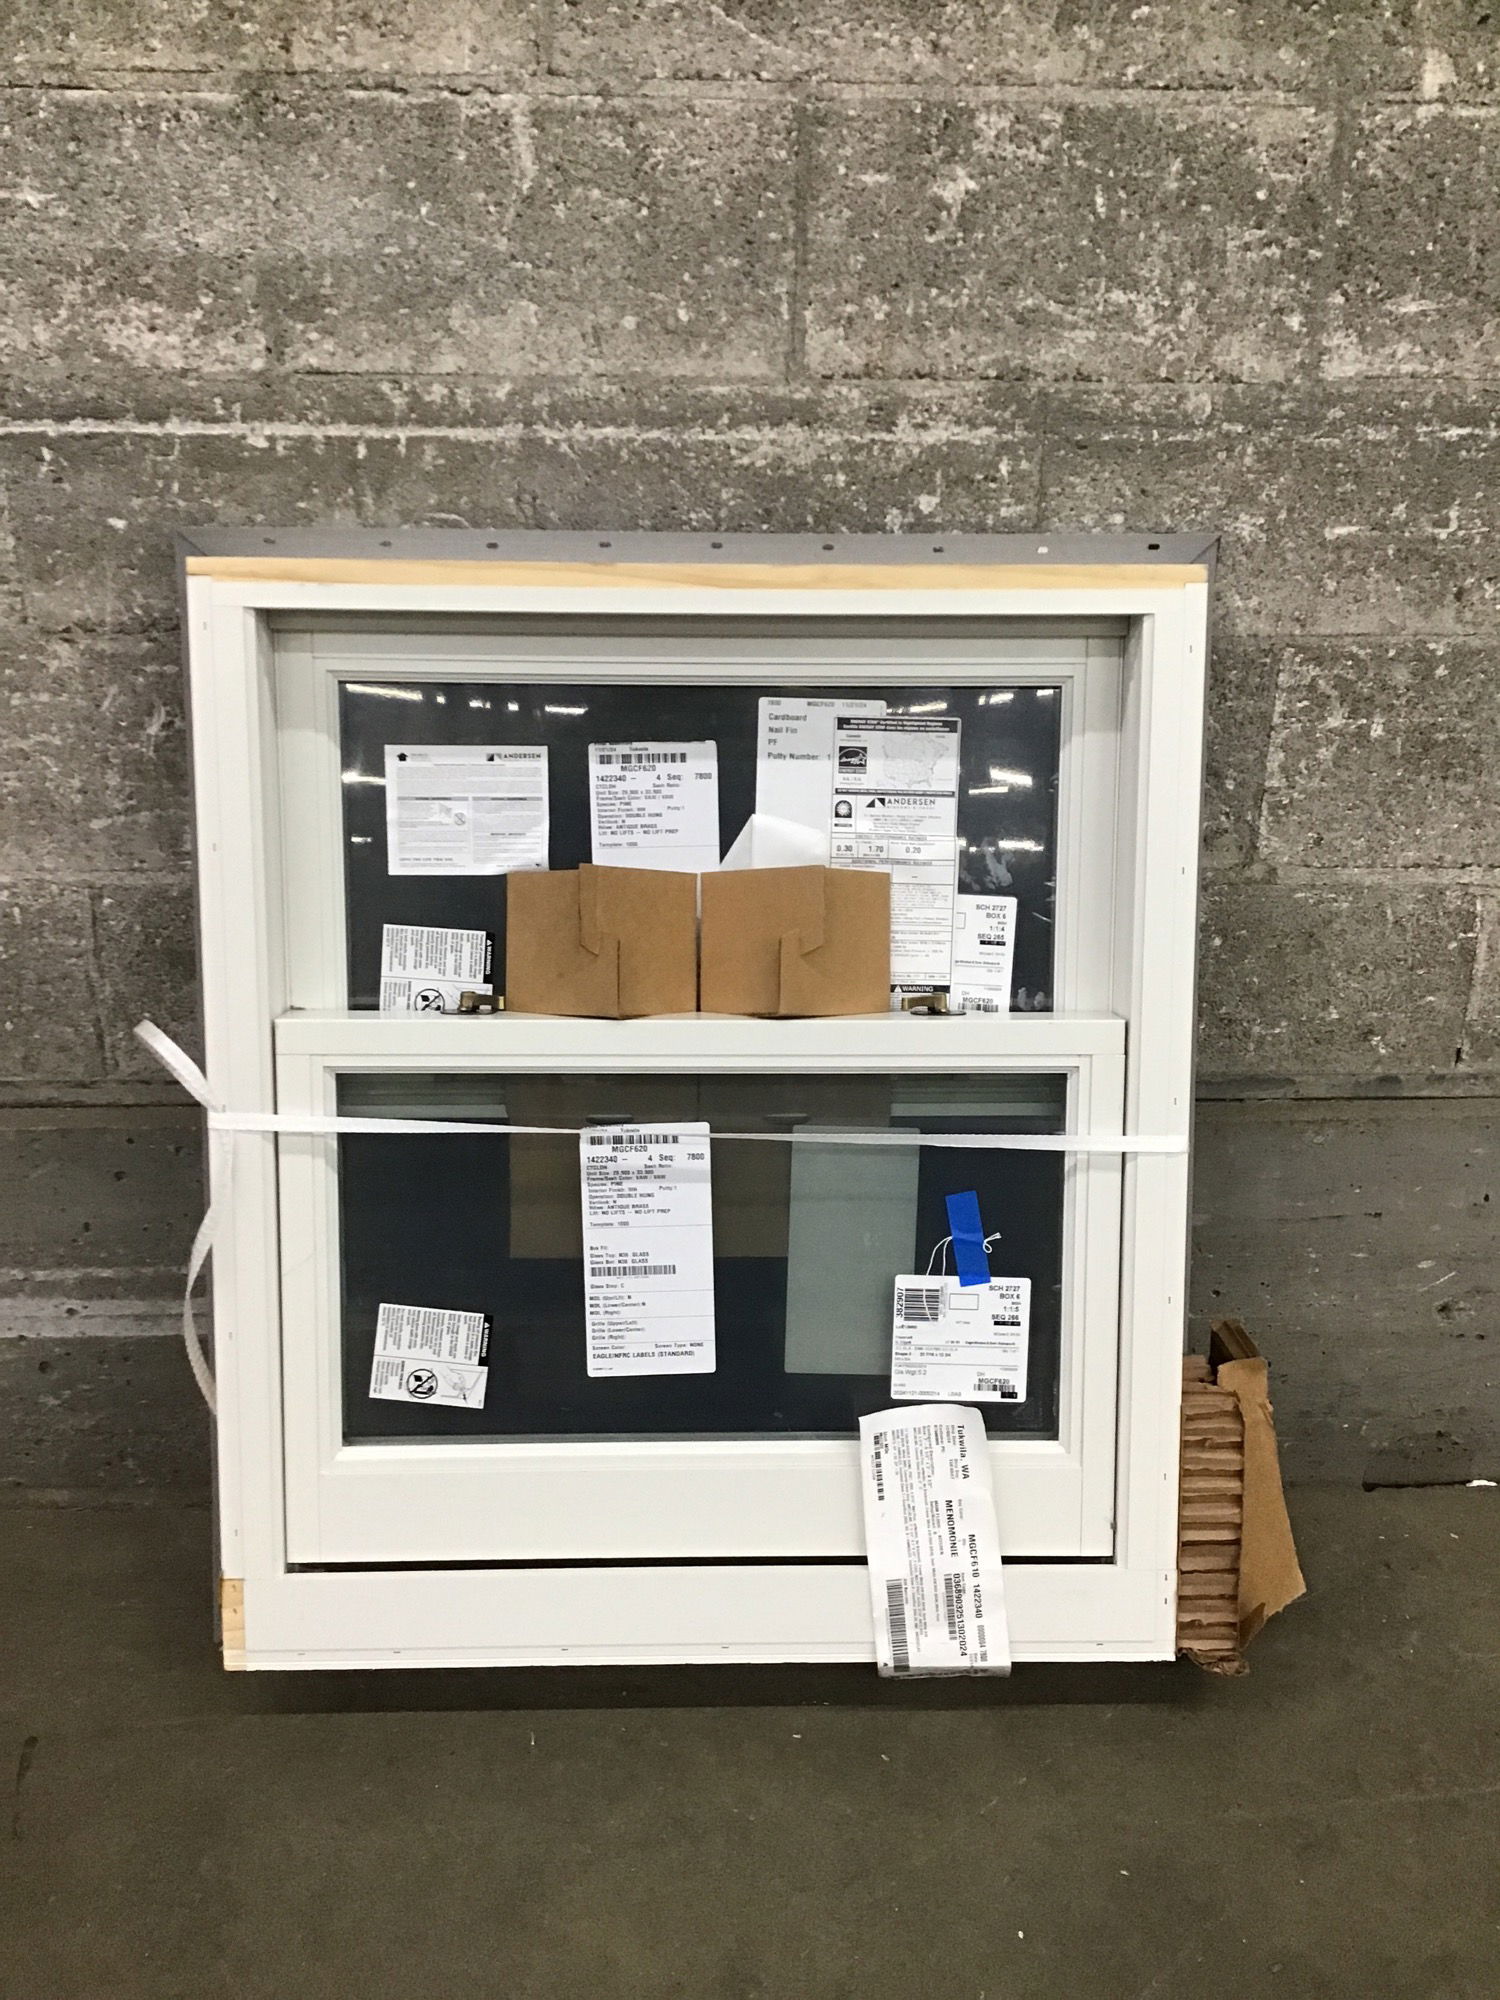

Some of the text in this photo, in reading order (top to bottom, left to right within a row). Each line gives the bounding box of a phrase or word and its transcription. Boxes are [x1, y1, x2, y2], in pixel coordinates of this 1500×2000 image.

[768, 713, 808, 722] Cardboard
[768, 726, 798, 734] Nail Fin
[768, 738, 777, 746] PF
[767, 752, 786, 761] Putty
[620, 764, 657, 772] MGCF620
[595, 774, 627, 782] 1422340
[694, 772, 713, 780] 7800
[886, 798, 936, 806] ANDERSEN
[836, 844, 853, 853] 0.30
[868, 845, 884, 853] 1.70
[905, 846, 922, 854] 0.20
[611, 1145, 648, 1153] MGCF620
[586, 1155, 618, 1163] 1422340
[686, 1152, 705, 1161] 7800
[896, 1287, 904, 1318] 382907
[481, 1328, 489, 1358] WARNING
[657, 1350, 696, 1358] (STANDARD)
[977, 1377, 1011, 1385] MGCF620
[961, 1464, 970, 1480] WA
[945, 1499, 959, 1558] MENOMONIE
[968, 1533, 980, 1578] MGCF610
[972, 1583, 983, 1619] 1422340
[953, 1572, 968, 1657] 0368903251302024
